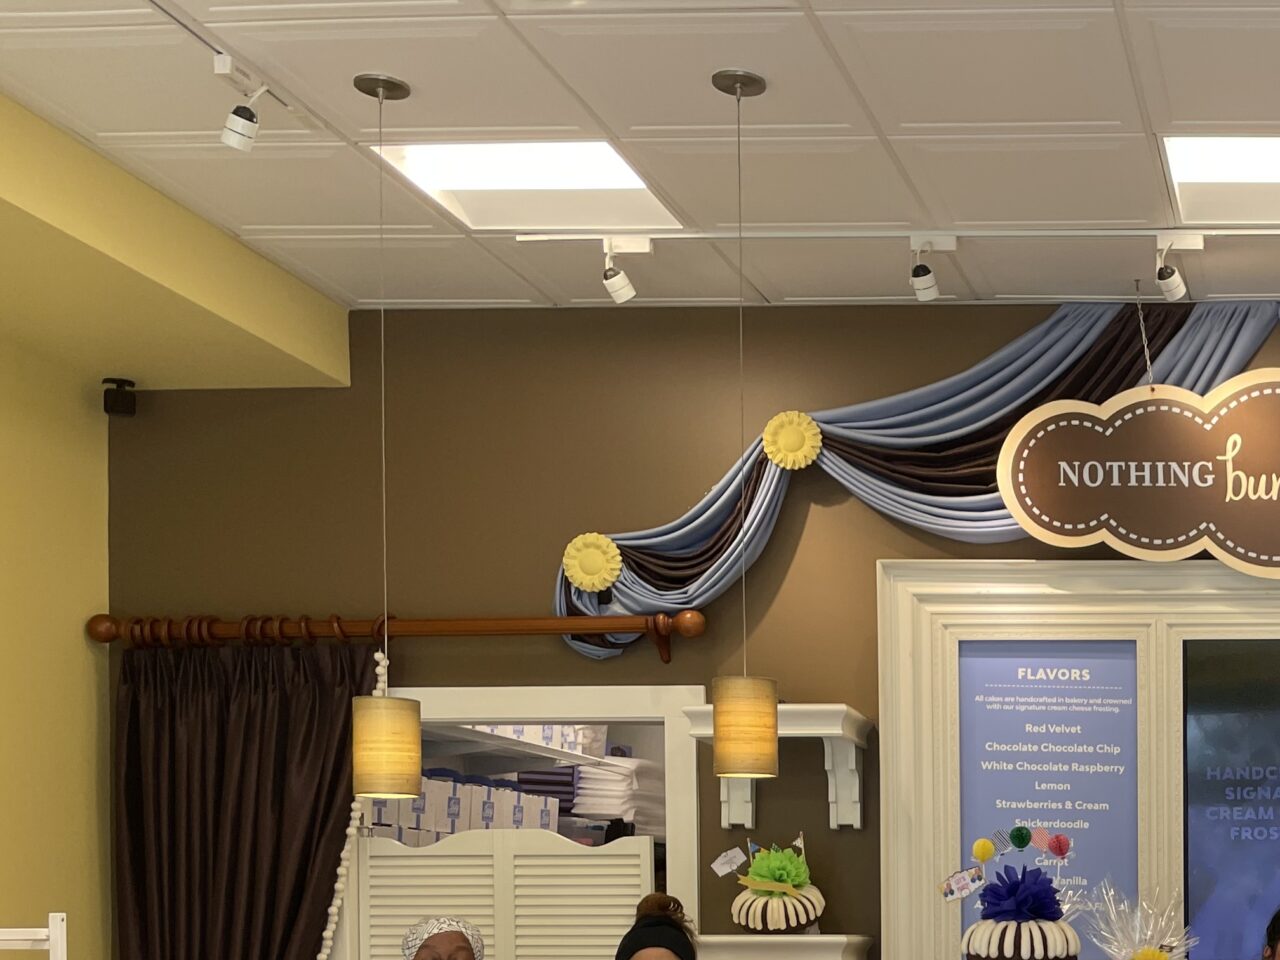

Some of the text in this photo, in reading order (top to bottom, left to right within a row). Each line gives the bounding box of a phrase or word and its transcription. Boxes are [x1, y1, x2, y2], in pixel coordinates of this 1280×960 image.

[1057, 459, 1216, 488] NOTHING
[1017, 667, 1091, 681] FLAVORS
[1016, 695, 1057, 704] handcrafted
[1065, 696, 1088, 706] bakery
[986, 703, 1002, 711] with
[1015, 704, 1046, 712] signature
[1025, 723, 1082, 734] Red Velvet
[985, 742, 1121, 755] Chocolate Chocolate Chip
[981, 761, 1125, 775] White Chocolate Raspberry
[1034, 781, 1071, 791] Lemon
[995, 799, 1110, 811] Strawberries & Cream
[1205, 806, 1275, 821] CREAM
[1015, 818, 1090, 829] Snickerdoodle
[1034, 857, 1069, 867] Carrot
